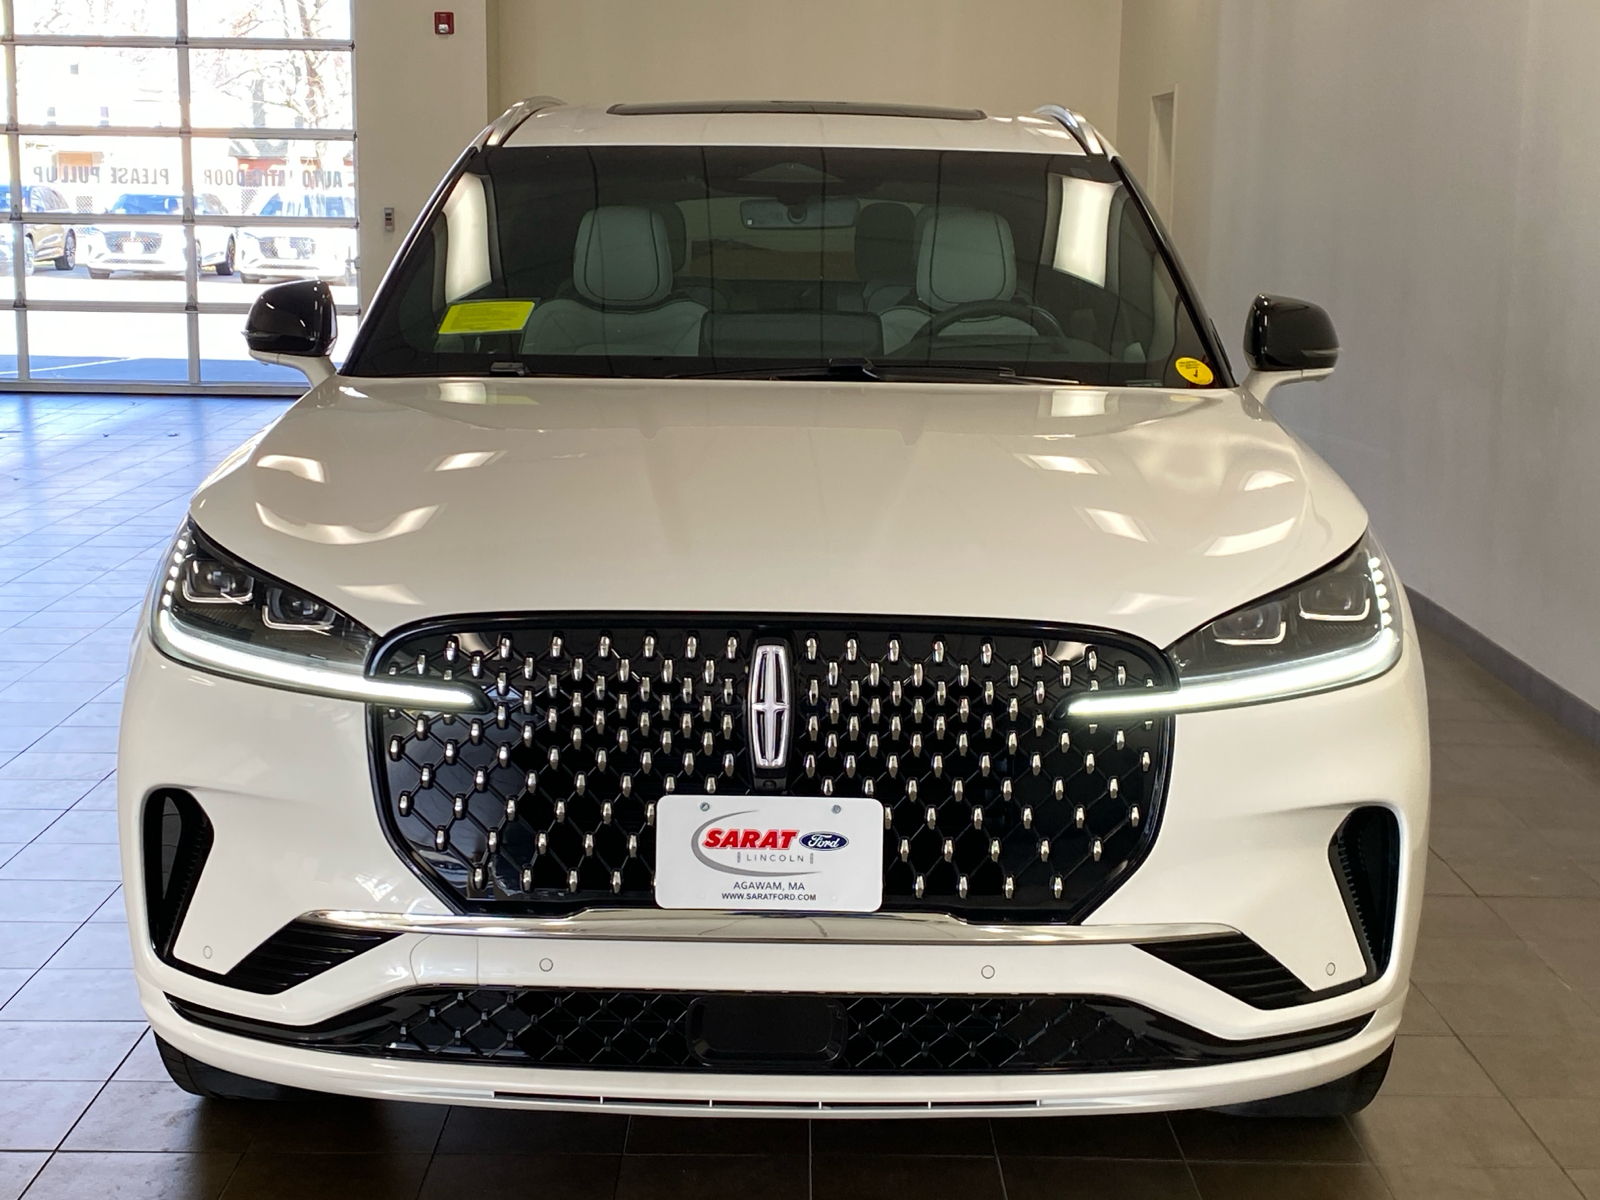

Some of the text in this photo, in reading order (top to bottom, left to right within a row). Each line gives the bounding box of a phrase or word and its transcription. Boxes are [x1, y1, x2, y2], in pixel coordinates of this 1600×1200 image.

[703, 828, 840, 850] SARAT Ford
[746, 853, 804, 863] LINCOLN
[733, 881, 805, 892] AGAWAM, MA
[721, 892, 817, 901] WWW.SARATFORD.COM
